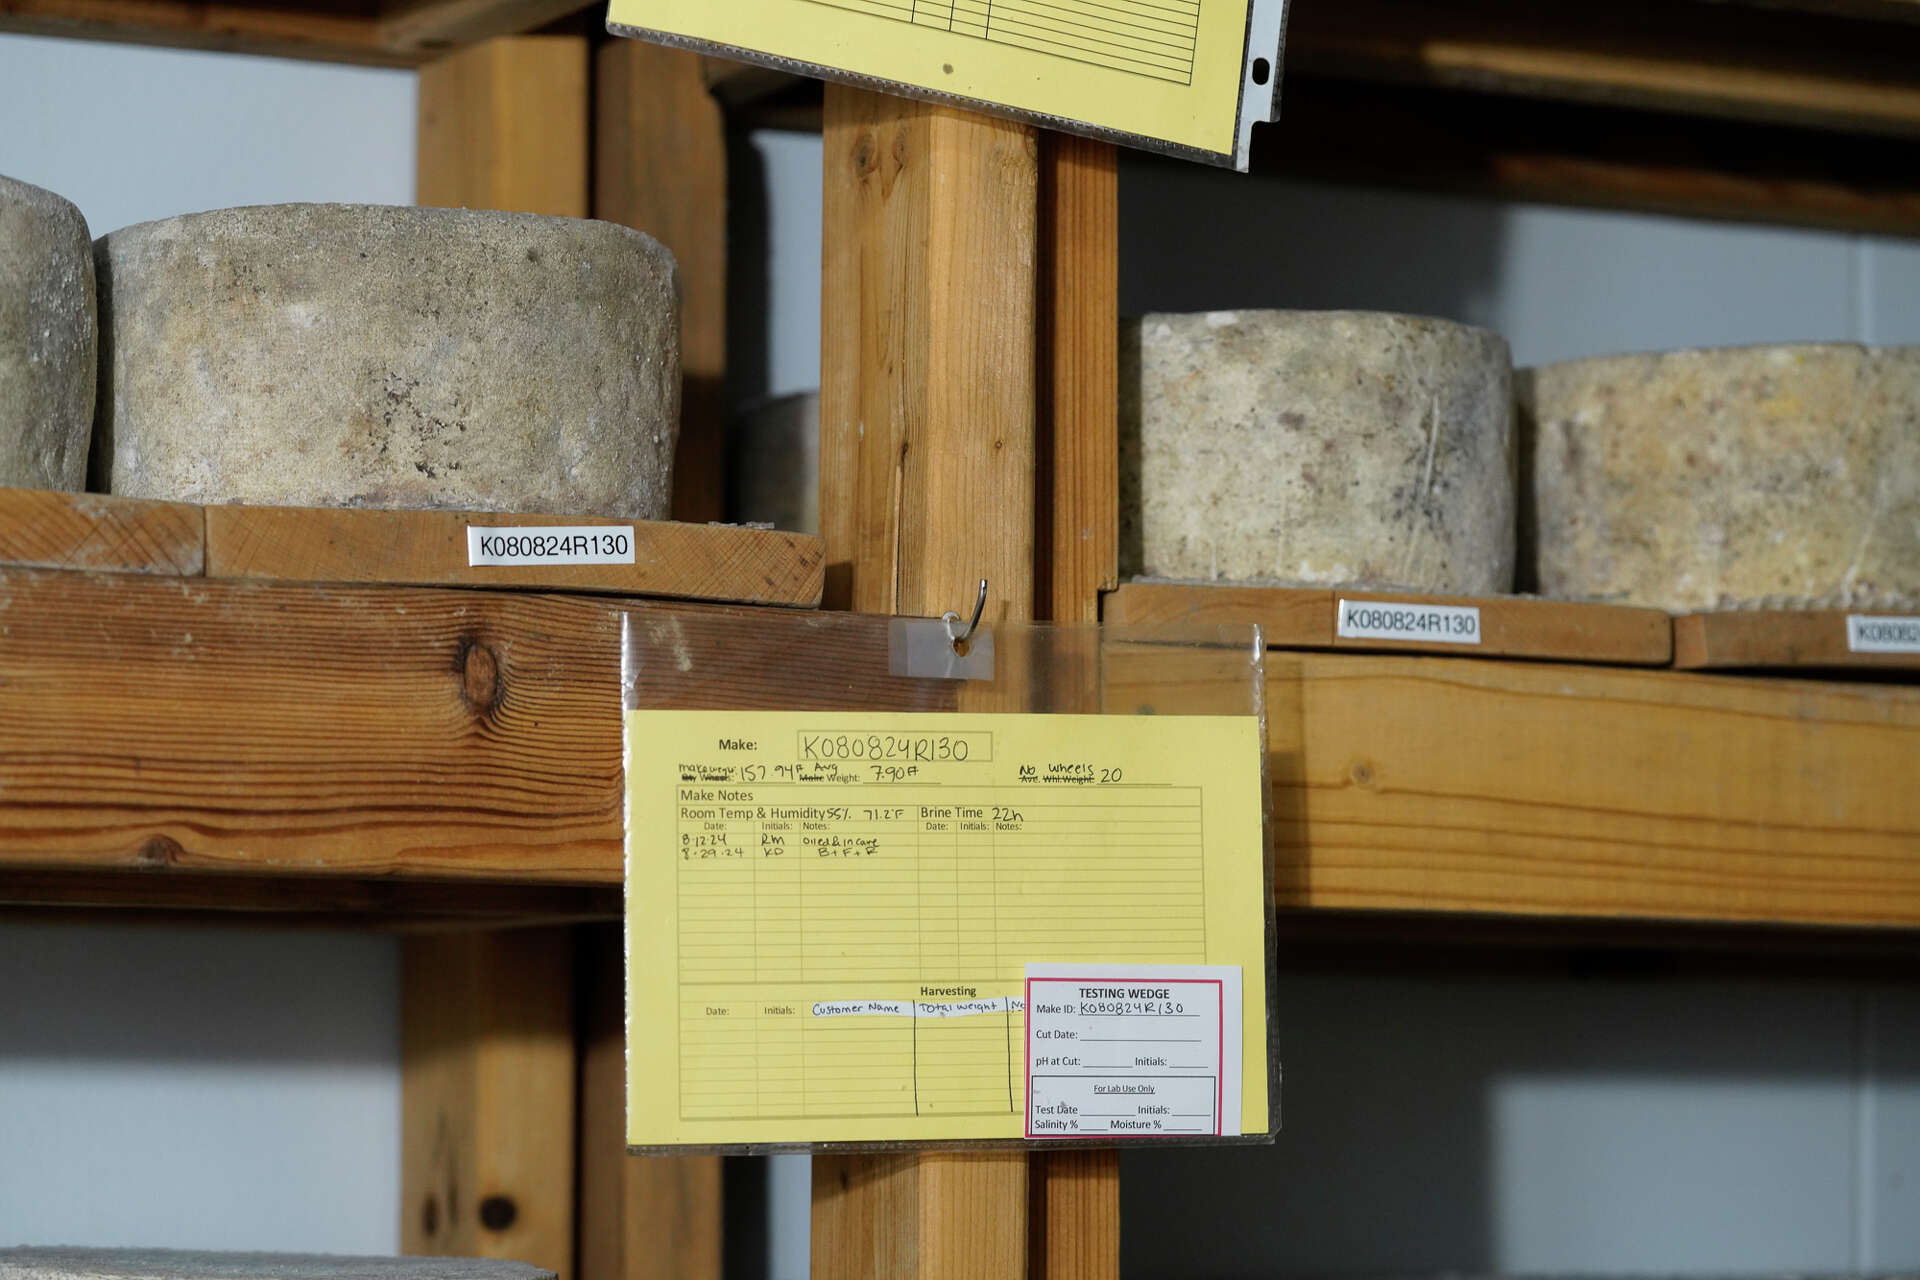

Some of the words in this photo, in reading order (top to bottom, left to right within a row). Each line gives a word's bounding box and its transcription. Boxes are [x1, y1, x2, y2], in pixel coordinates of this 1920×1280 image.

[481, 535, 628, 557] K080824R130
[1347, 609, 1476, 635] K080824R130
[1858, 622, 1920, 642] K08082
[718, 738, 758, 751] Make:
[803, 735, 968, 762] K080824R130
[826, 773, 860, 784] Weight:
[1100, 768, 1122, 783] 20
[680, 790, 714, 801] Make
[718, 790, 754, 801] Notes
[680, 808, 716, 819] Room
[720, 808, 754, 821] Temp
[756, 808, 768, 819] &
[771, 807, 825, 821] Humidity
[921, 807, 952, 818] Brine
[956, 807, 983, 818] Time
[992, 807, 1024, 822] 22h
[704, 822, 728, 830] Date:
[761, 822, 793, 830] Initials:
[803, 822, 830, 830] Notes:
[926, 822, 949, 831] Date:
[960, 822, 990, 831] Initials:
[995, 822, 1022, 831] Notes:
[920, 986, 977, 998] Harvesting
[1079, 988, 1125, 999] TESTING
[1128, 989, 1170, 999] WEDGE
[706, 1007, 730, 1016] Date:
[764, 1006, 796, 1015] Initials:
[812, 1003, 863, 1017] Customer
[868, 1003, 900, 1013] Name
[1036, 1003, 1062, 1014] Make
[1064, 1004, 1076, 1014] ID:
[1080, 1002, 1184, 1015] K080824R130
[1036, 1030, 1052, 1040] Cut
[1054, 1030, 1078, 1040] Date:
[1036, 1057, 1049, 1068] pH
[1051, 1057, 1060, 1066] at
[1062, 1056, 1081, 1067] Cut:
[1135, 1057, 1168, 1067] Initials:
[1094, 1084, 1106, 1093] For
[1107, 1084, 1121, 1094] Lab
[1122, 1084, 1137, 1094] Use
[1138, 1084, 1155, 1096] Only
[1036, 1105, 1054, 1115] Test
[1057, 1105, 1078, 1115] Date
[1138, 1106, 1170, 1116] Initials:
[1035, 1119, 1068, 1131] Salinity
[1069, 1120, 1079, 1130] %
[1110, 1120, 1151, 1130] Moisture
[1153, 1120, 1162, 1130] %
